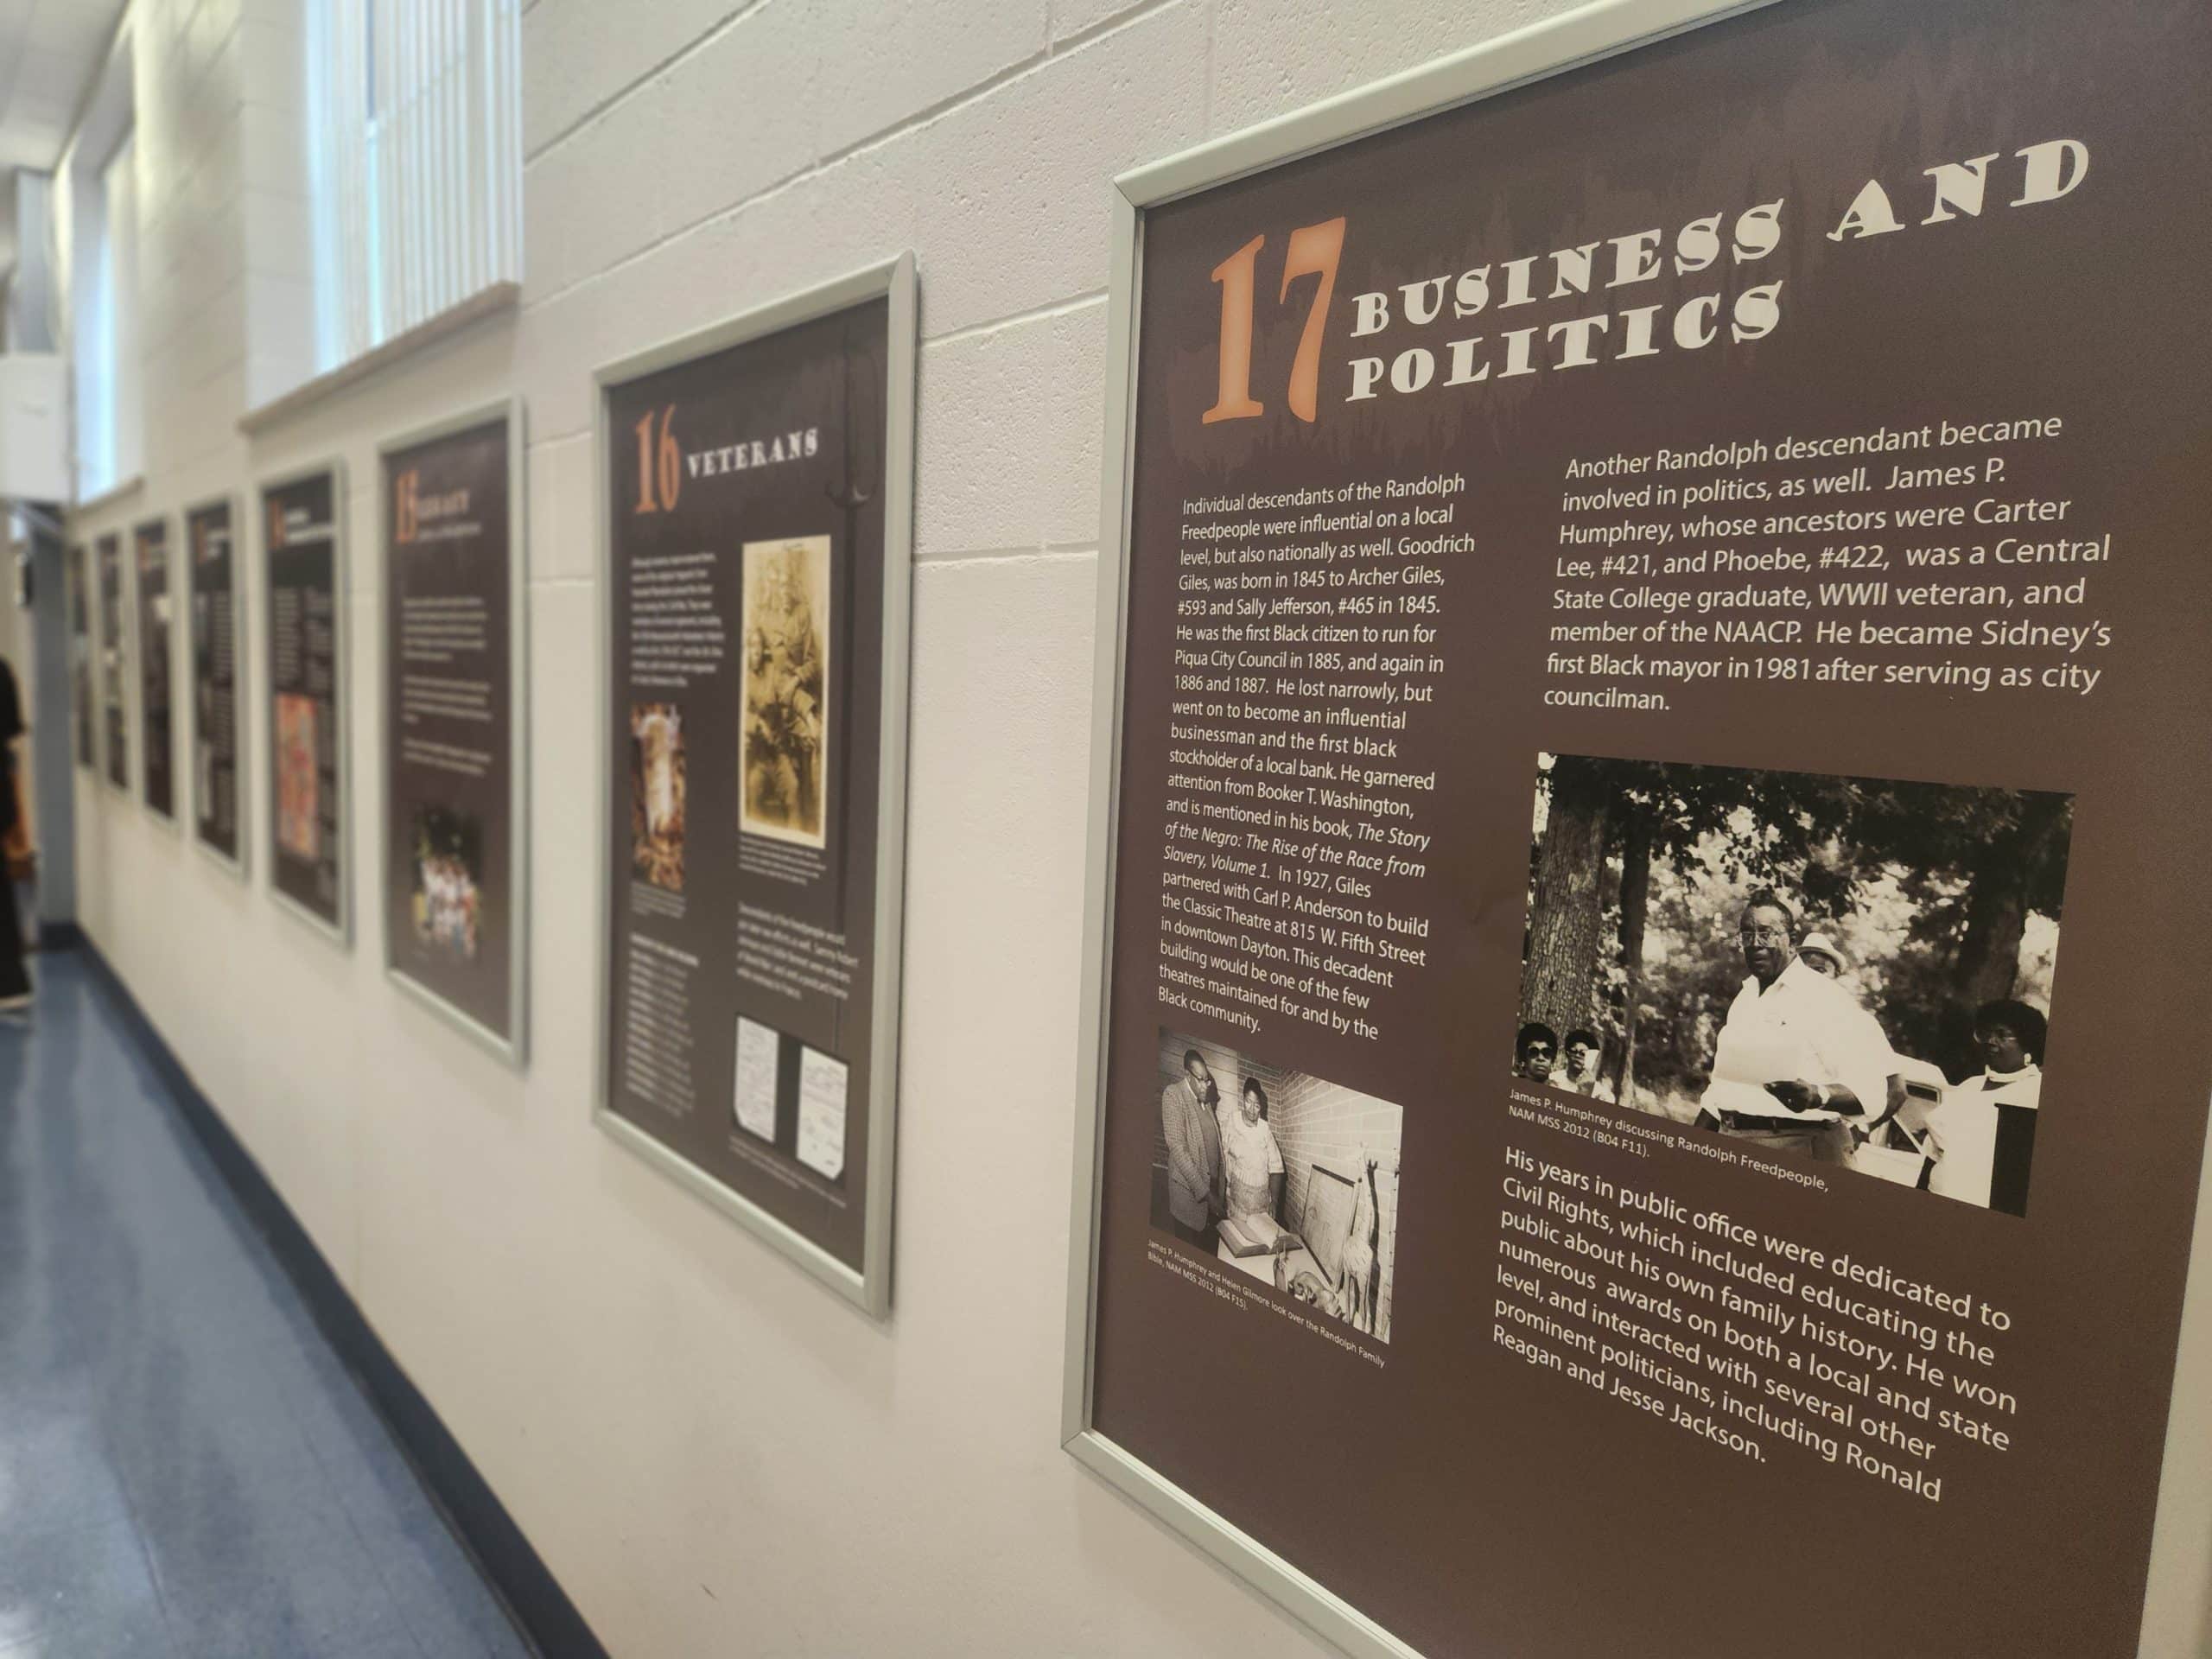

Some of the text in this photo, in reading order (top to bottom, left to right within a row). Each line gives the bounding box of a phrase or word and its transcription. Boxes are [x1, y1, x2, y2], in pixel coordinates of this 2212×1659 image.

[1350, 139, 2089, 338] BUSINESS AND
[1202, 216, 1346, 424] 17
[1345, 279, 1783, 403] POLITICS
[635, 403, 818, 513] 16 VETERANS
[1565, 417, 2063, 480] Another Randolph descendant became
[1183, 473, 1465, 515] Individual descendants of the Randolph
[1563, 457, 2005, 512] involved in politics, as well. James P.
[1556, 533, 2110, 579] Lee, #421, and Phoebe, #422, was a Central
[1560, 499, 2071, 548] Humphrey, whose ancestors were Carter
[1178, 595, 1440, 620] #593 and Sally Jefferson, #465 in 1845.
[1553, 576, 2086, 613] State College graduate, WWII veteran, and
[1550, 620, 2111, 653] member of the NAACP. He became Sidney’s
[1544, 686, 1670, 710] councilman.
[1547, 652, 2101, 696] first Black mayor in 1981 after serving as city
[1171, 721, 1397, 758] businessman and the first black
[1161, 916, 1394, 988] in downtown Dayton. This decadent
[1159, 986, 1261, 1033] Black community.
[1509, 1105, 1649, 1158] NAM MSS 2012 (B04 F11).
[1510, 1089, 1828, 1192] James P. Humphrey discussing Randolph Freedpeople,
[1503, 1177, 1994, 1366] Civil Rights, which included educating the
[1505, 1146, 2011, 1331] His years in public office were dedicated to
[1147, 1251, 1164, 1268] Bible,
[1166, 1260, 1181, 1274] NAM
[1183, 1268, 1197, 1283] MSS
[1198, 1277, 1214, 1293] 2012
[1215, 1286, 1230, 1300] (B04
[1147, 1239, 1385, 1369] James P. Humphrey and Helen Gilmore look over the Randolph Family
[1499, 1239, 2010, 1452] numerous awards on both a local and state
[1501, 1210, 2016, 1414] public about his own family history. He won
[1493, 1324, 1766, 1463] Reagan and Jesse Jackson.
[1497, 1264, 1936, 1460] level, and interacted with several other
[1495, 1299, 1942, 1503] prominent politicians, including Ronald
